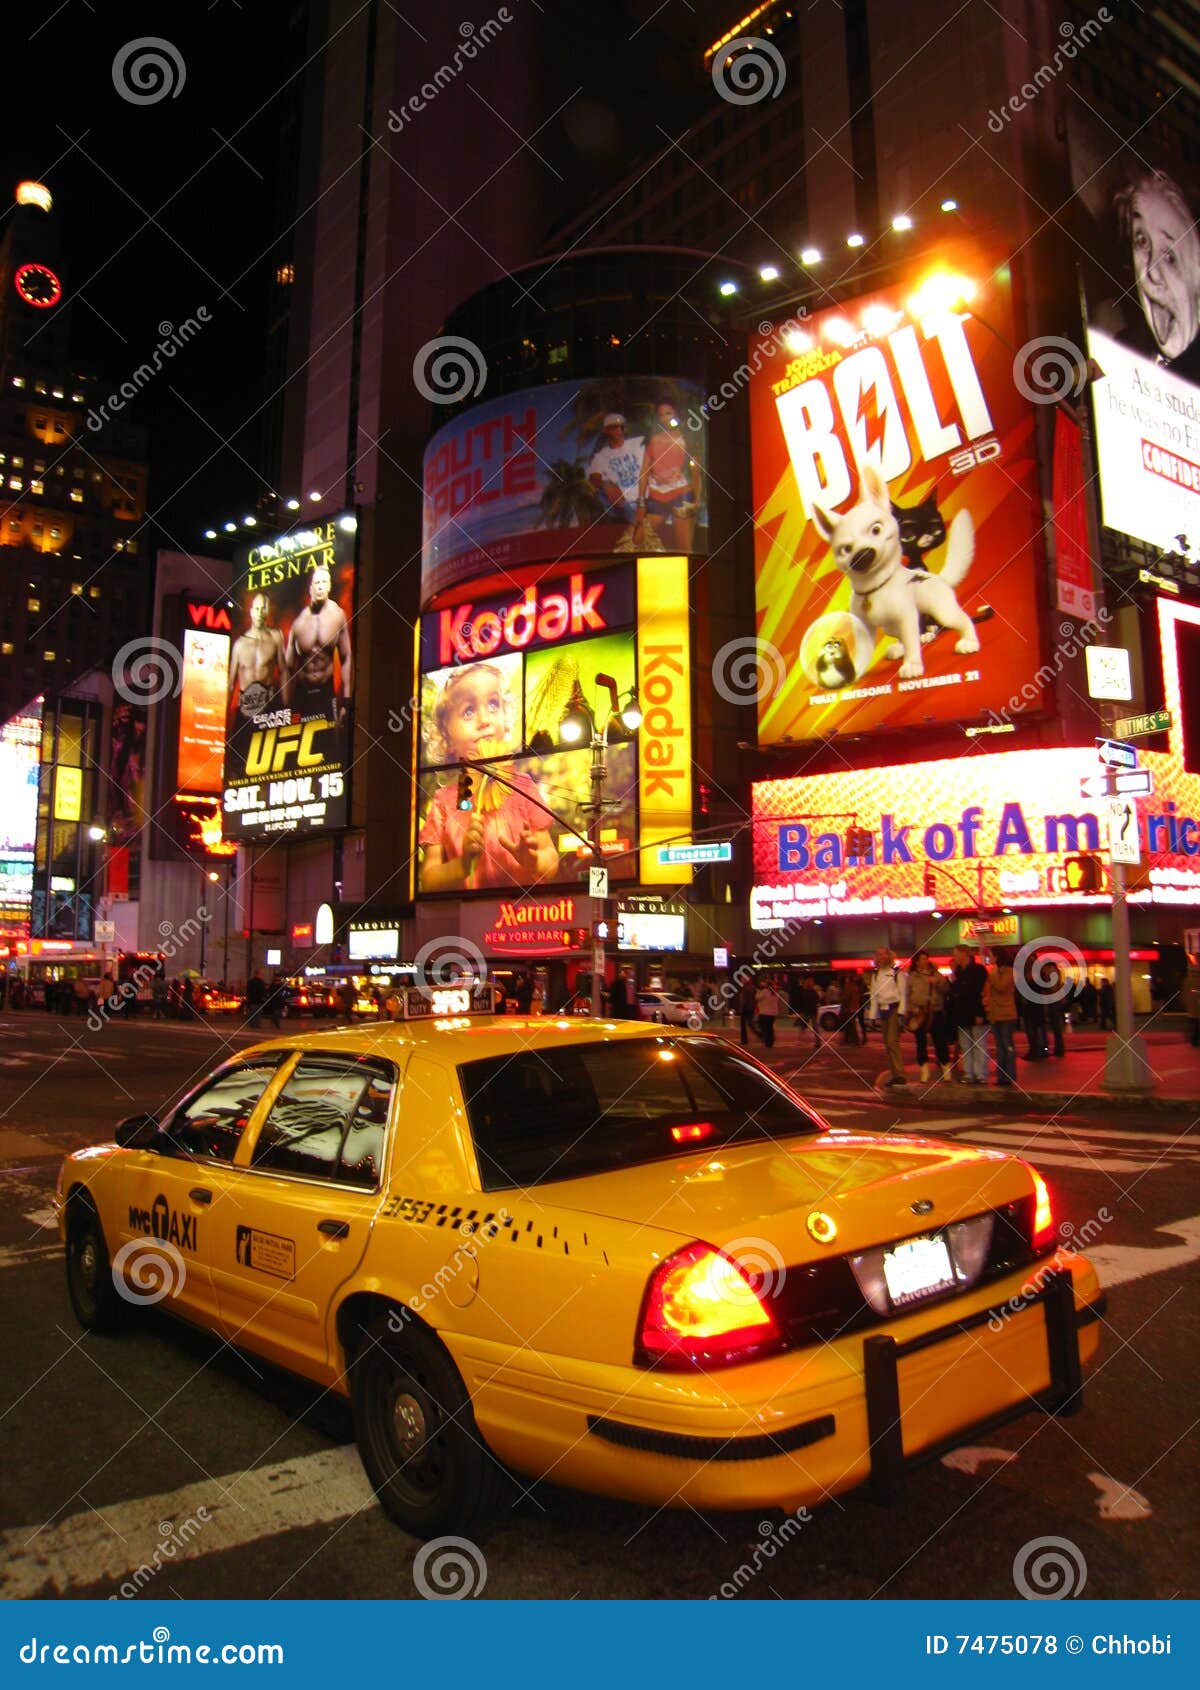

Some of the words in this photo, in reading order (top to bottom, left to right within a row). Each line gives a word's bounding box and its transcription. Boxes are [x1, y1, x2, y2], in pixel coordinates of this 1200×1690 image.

[771, 350, 842, 396] TRAVOLTA
[775, 309, 994, 520] BOLT
[432, 450, 537, 533] POLE
[248, 548, 336, 591] LESNAR
[438, 573, 607, 666] Kodak
[841, 684, 892, 701] AWESOME
[898, 673, 961, 693] NOVEMBER
[965, 670, 980, 682] 21
[642, 644, 685, 798] Kodak
[1127, 715, 1157, 735] TIMES
[245, 719, 329, 776] UFC
[224, 785, 266, 812] SAT.
[269, 777, 316, 806] NOV.
[318, 771, 344, 799] 15
[1110, 803, 1123, 817] NO
[923, 806, 985, 862] of
[993, 801, 1200, 857] Amric
[668, 848, 720, 861] Broadway
[1113, 842, 1136, 857] TURN
[495, 899, 574, 929] Marriott
[617, 902, 685, 913] MARQUIS
[350, 920, 400, 930] MARQUIS
[485, 932, 506, 944] NEW
[509, 930, 535, 942] YORK
[383, 1194, 436, 1223] 3F53
